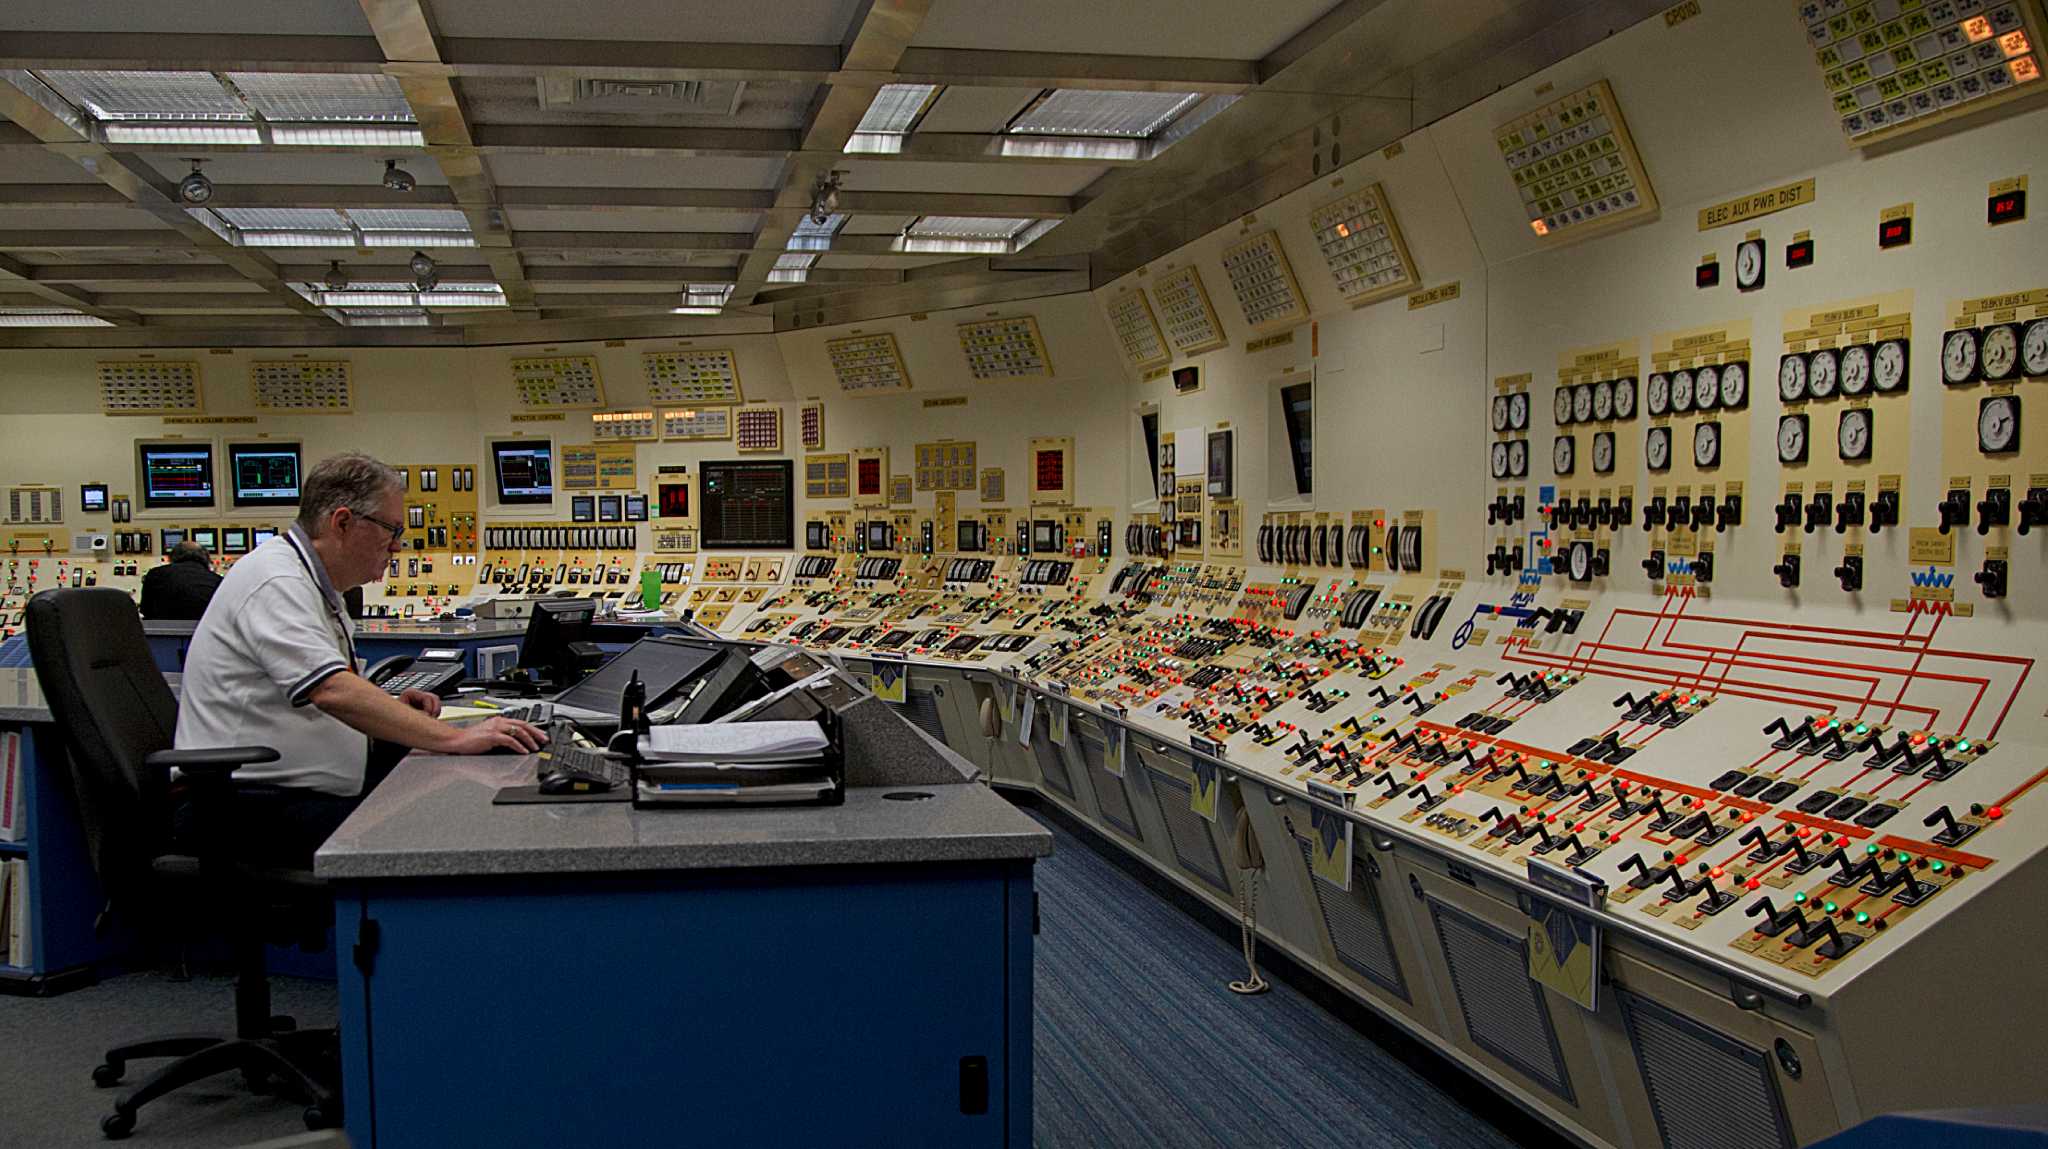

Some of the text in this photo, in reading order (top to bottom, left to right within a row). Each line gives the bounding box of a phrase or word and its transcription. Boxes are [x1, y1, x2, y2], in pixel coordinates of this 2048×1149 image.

[1707, 185, 1802, 225] ELEC AUX PWR DIST
